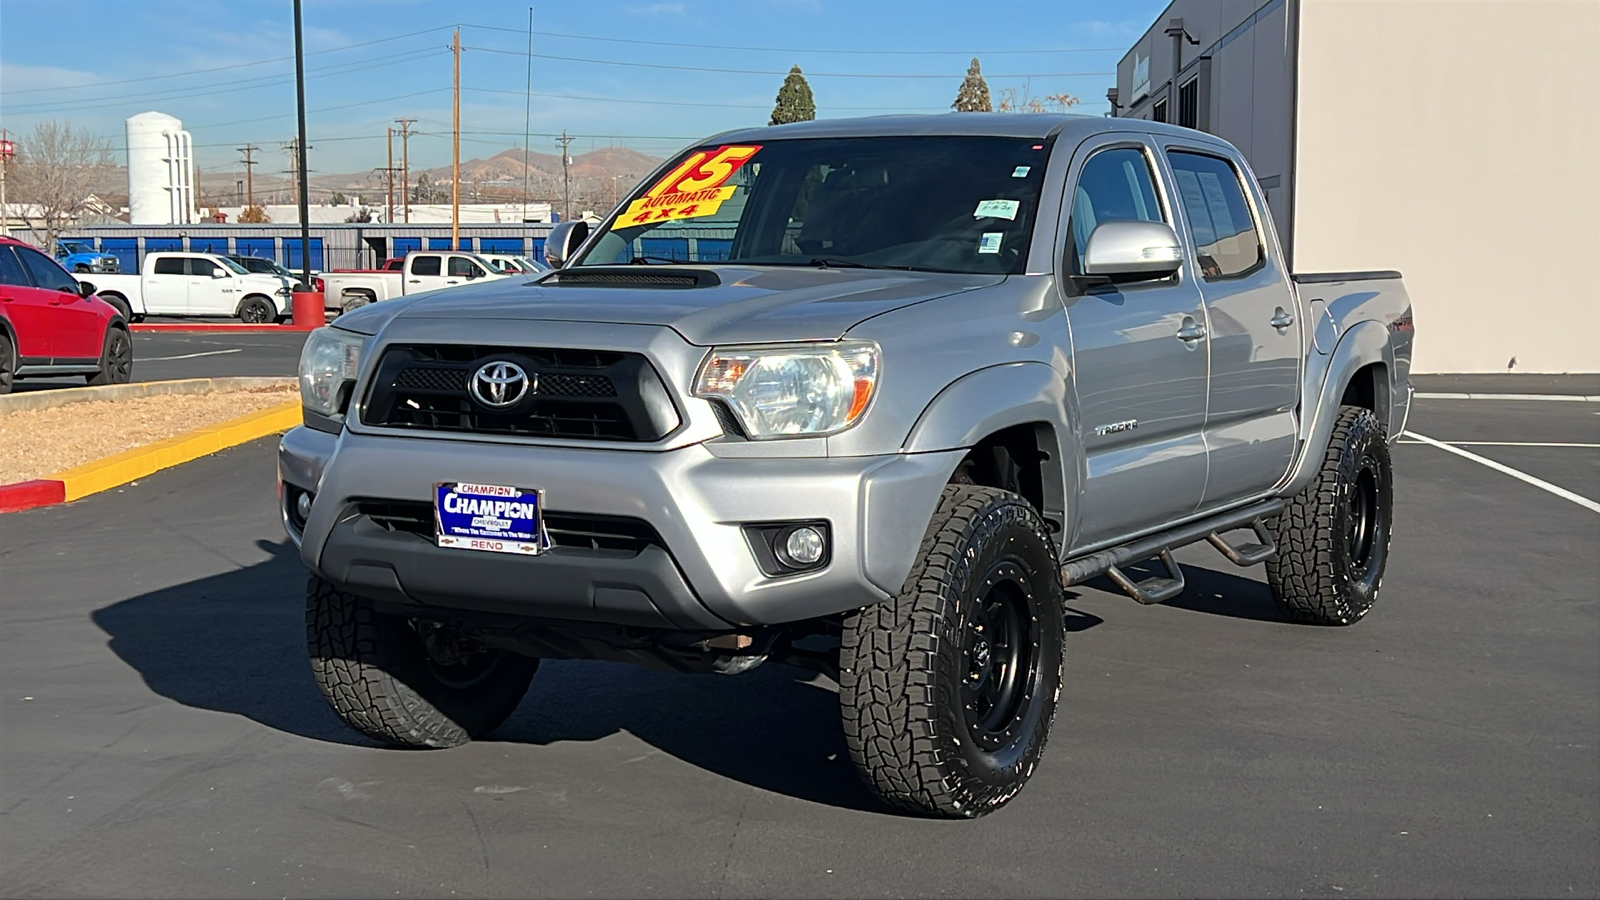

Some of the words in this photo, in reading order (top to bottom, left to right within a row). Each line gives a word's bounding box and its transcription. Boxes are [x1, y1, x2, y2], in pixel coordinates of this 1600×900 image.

[647, 147, 756, 197] 15
[640, 188, 721, 210] AUTOMATIC
[461, 484, 511, 496] CHAMPION
[443, 493, 534, 520] CHAMPION
[473, 518, 509, 527] CHEVROLET
[470, 540, 503, 550] RENO
